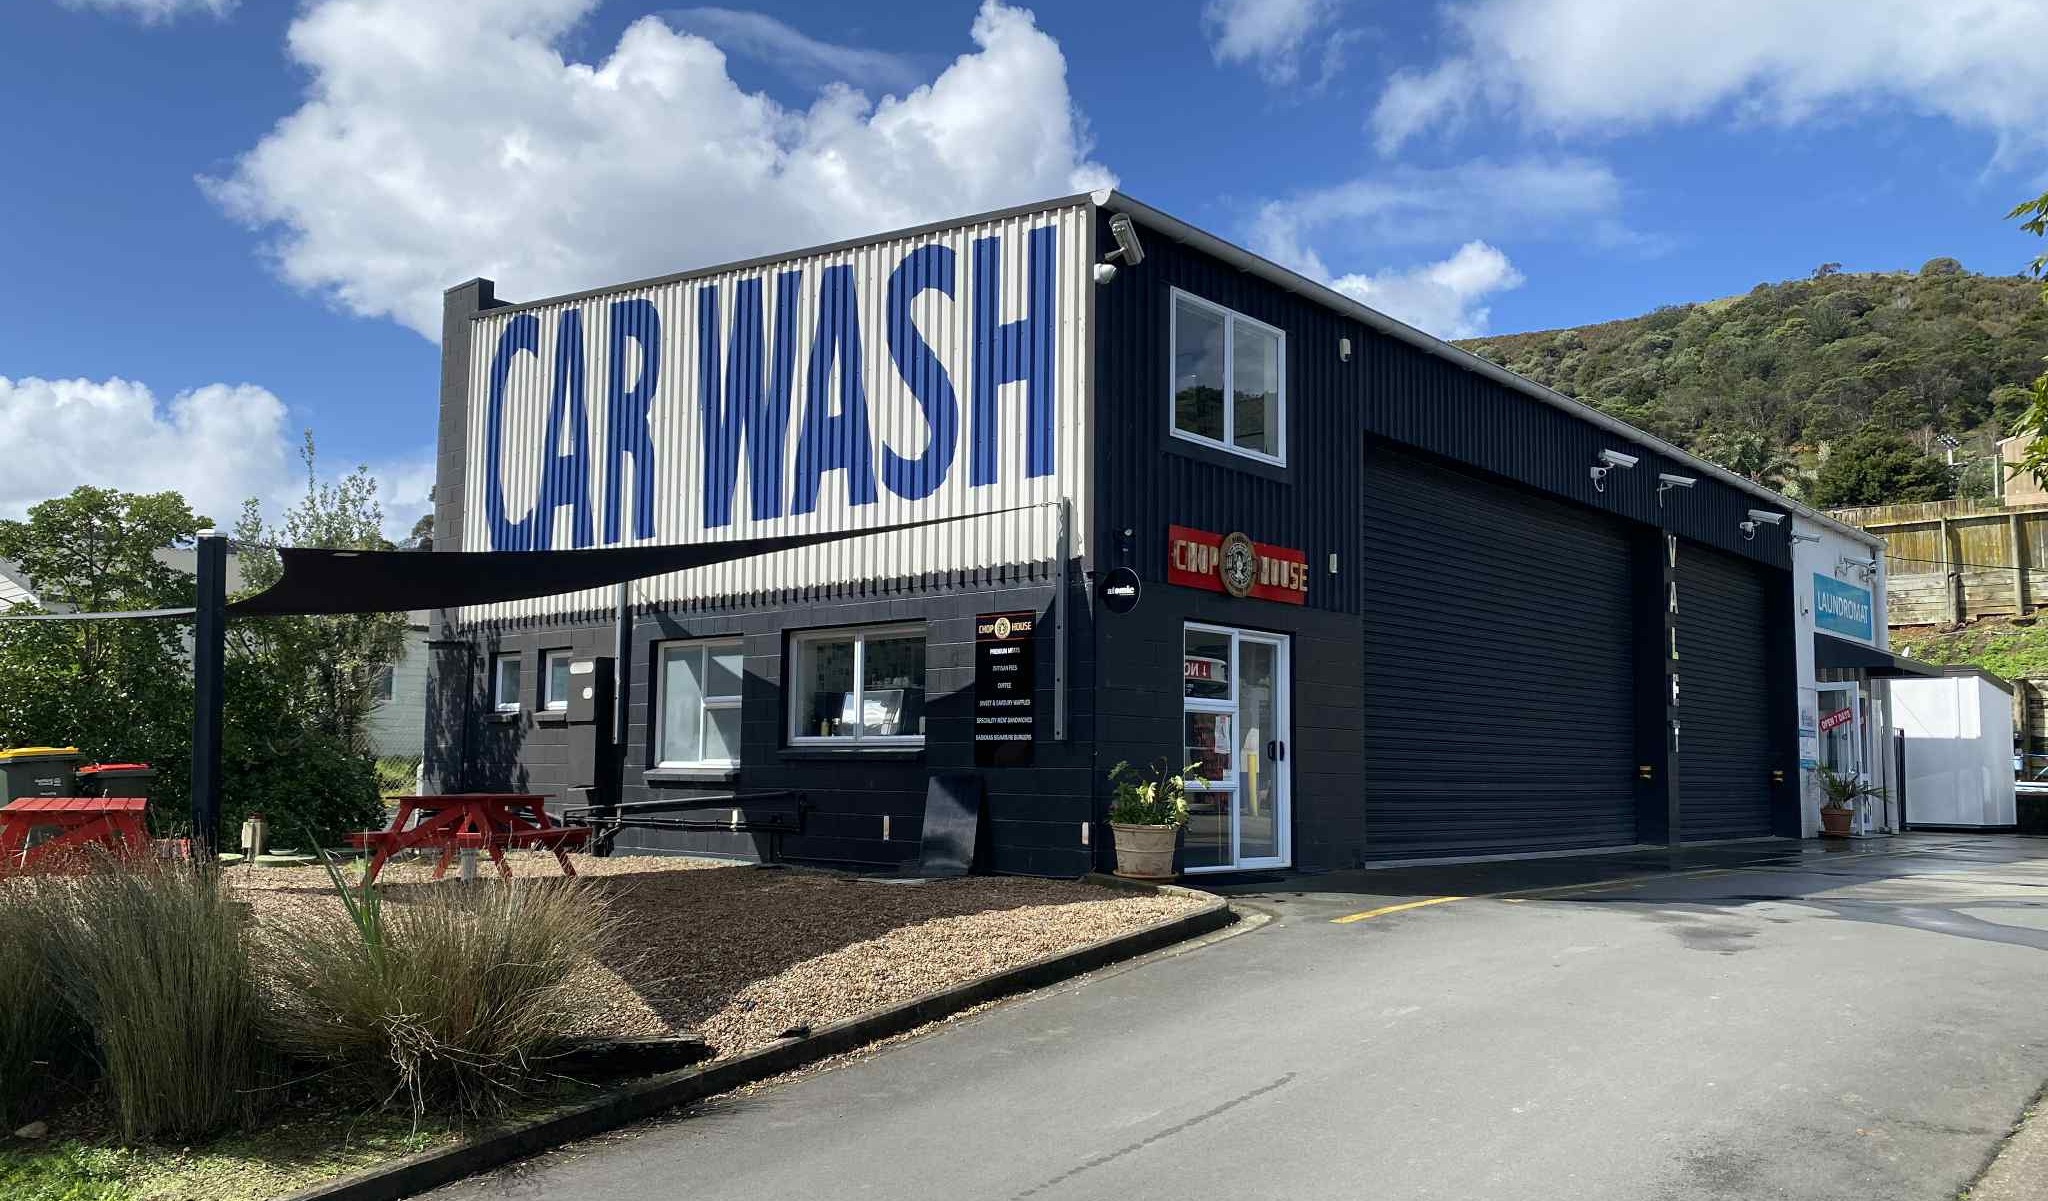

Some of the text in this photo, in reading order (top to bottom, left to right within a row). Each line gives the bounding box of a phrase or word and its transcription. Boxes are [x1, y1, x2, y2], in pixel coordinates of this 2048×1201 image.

[485, 224, 1057, 552] CAR WASH
[1173, 539, 1219, 575] CHOP
[1257, 555, 1309, 592] HOUSE
[1817, 591, 1869, 624] LAUNDROMAT
[978, 621, 1032, 634] CHOP HOUSE
[1821, 716, 1834, 730] OPEN
[1838, 710, 1851, 722] DAYS
